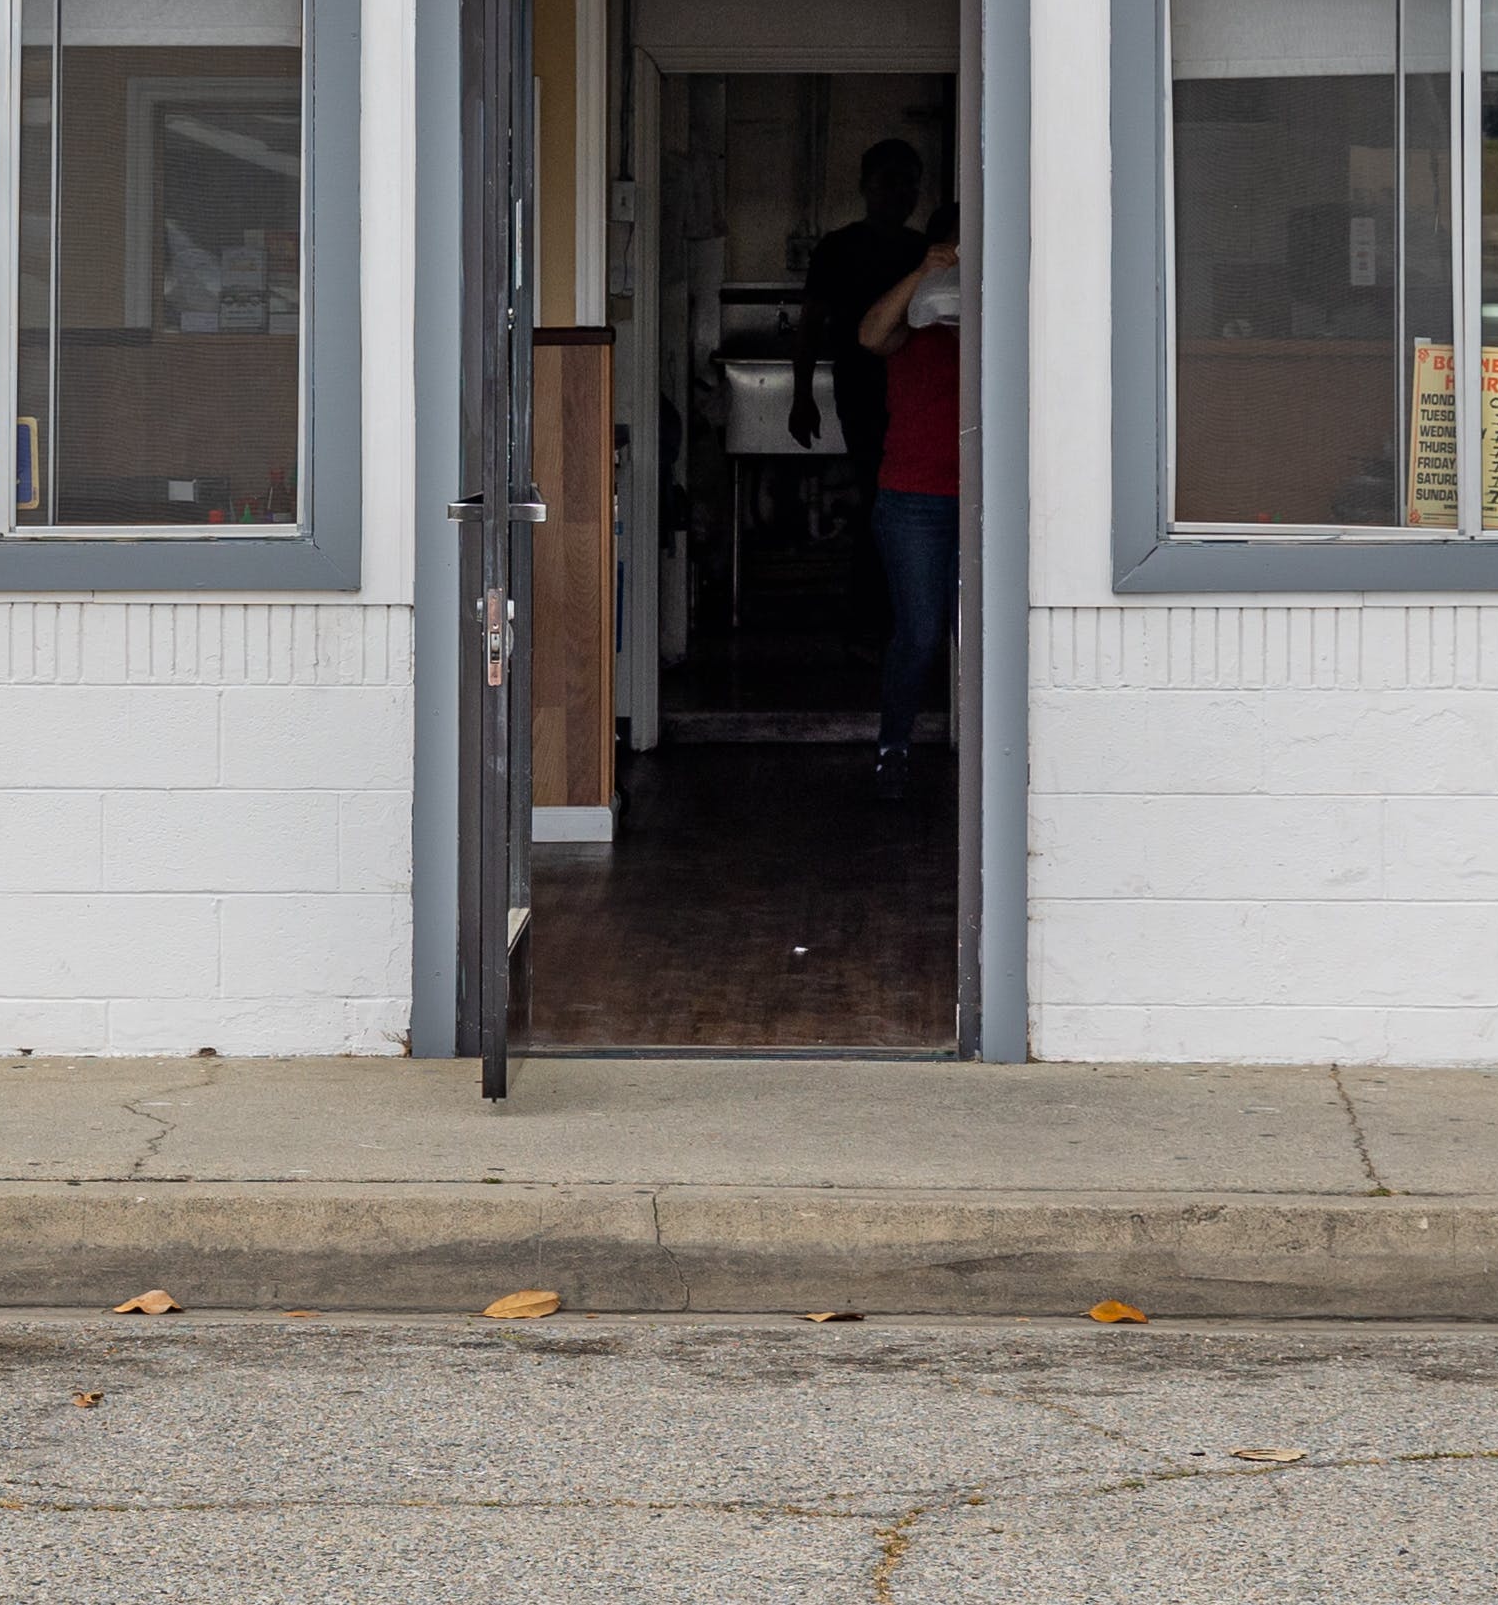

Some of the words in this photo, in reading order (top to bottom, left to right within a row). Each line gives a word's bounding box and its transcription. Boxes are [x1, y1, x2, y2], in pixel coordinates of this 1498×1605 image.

[1421, 393, 1455, 406] MOND
[1421, 409, 1455, 422] TUESD
[1417, 457, 1456, 470] FRIDAY
[1417, 473, 1457, 486] SATURD
